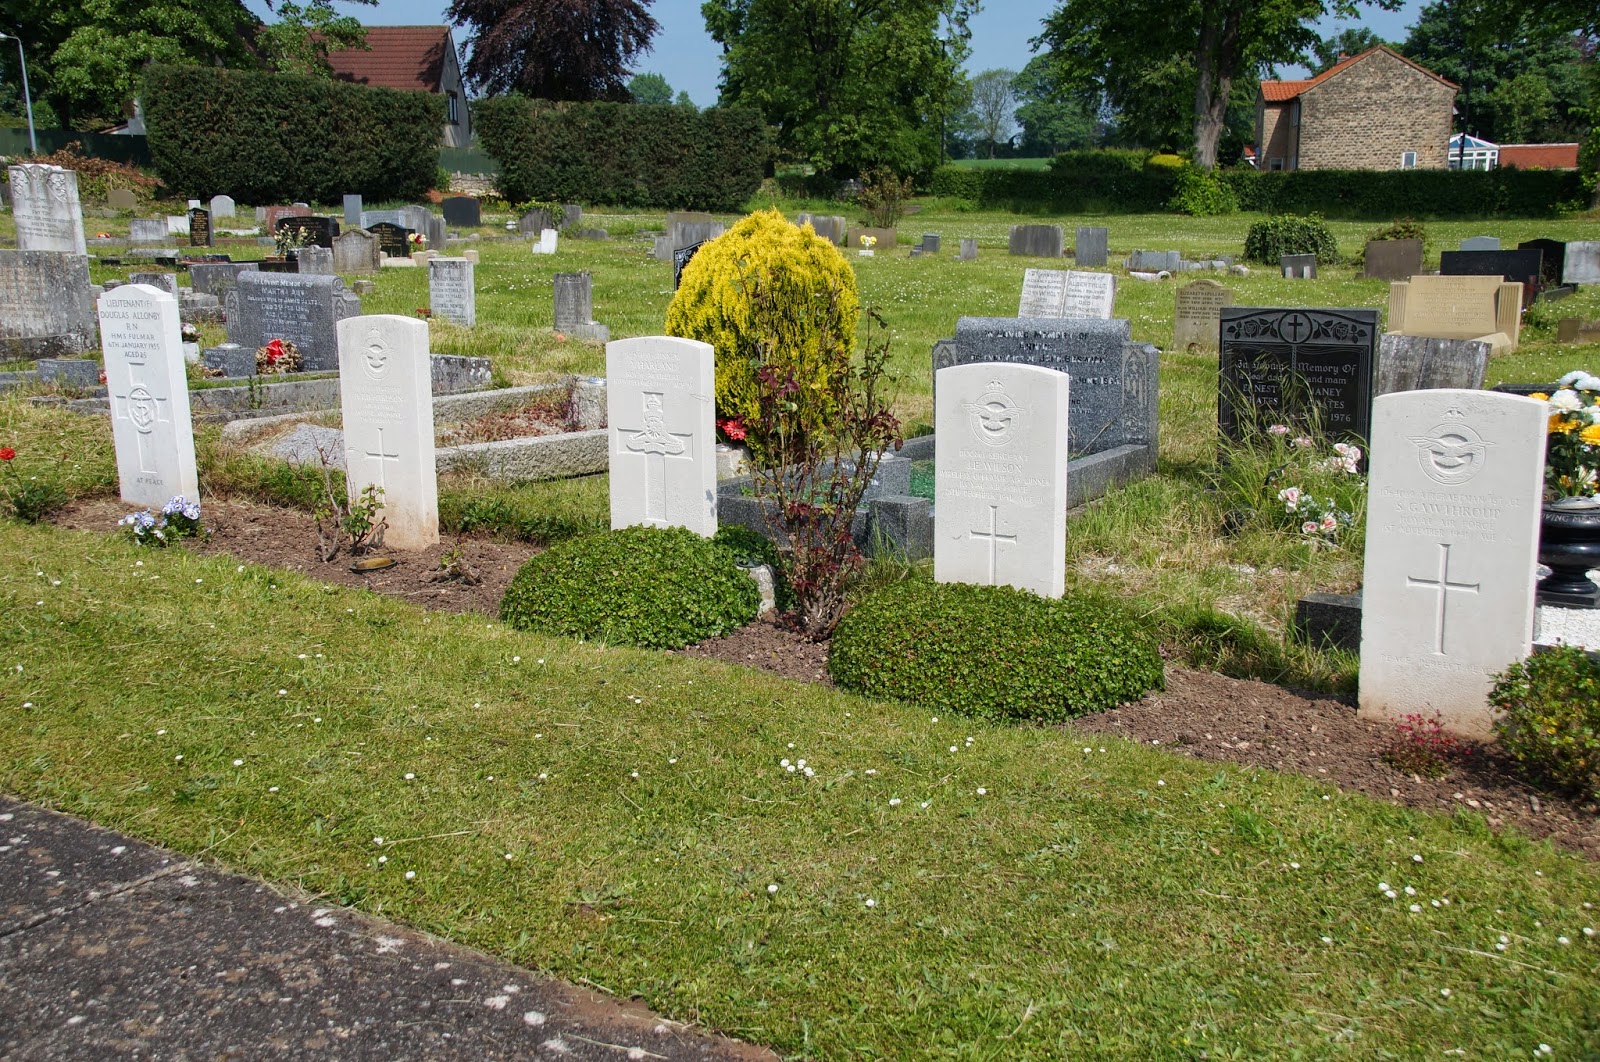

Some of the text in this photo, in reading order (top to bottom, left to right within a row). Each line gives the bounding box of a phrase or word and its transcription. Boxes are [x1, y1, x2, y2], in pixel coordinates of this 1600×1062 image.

[100, 310, 161, 320] DOUGLAS ALLONBY
[128, 333, 155, 341] FULMAR
[1297, 362, 1339, 375] Memory
[1342, 364, 1357, 376] Of
[1325, 377, 1347, 385] mam
[1330, 413, 1351, 422] 1976
[983, 461, 1023, 474] WILSON
[145, 478, 164, 486] PEACE
[1418, 489, 1485, 506] AIRCRAFTMAN
[1399, 515, 1496, 533] ROYAL AIR FORCE
[1399, 524, 1446, 538] NOVEMBER
[1419, 656, 1462, 671] PERFECT
